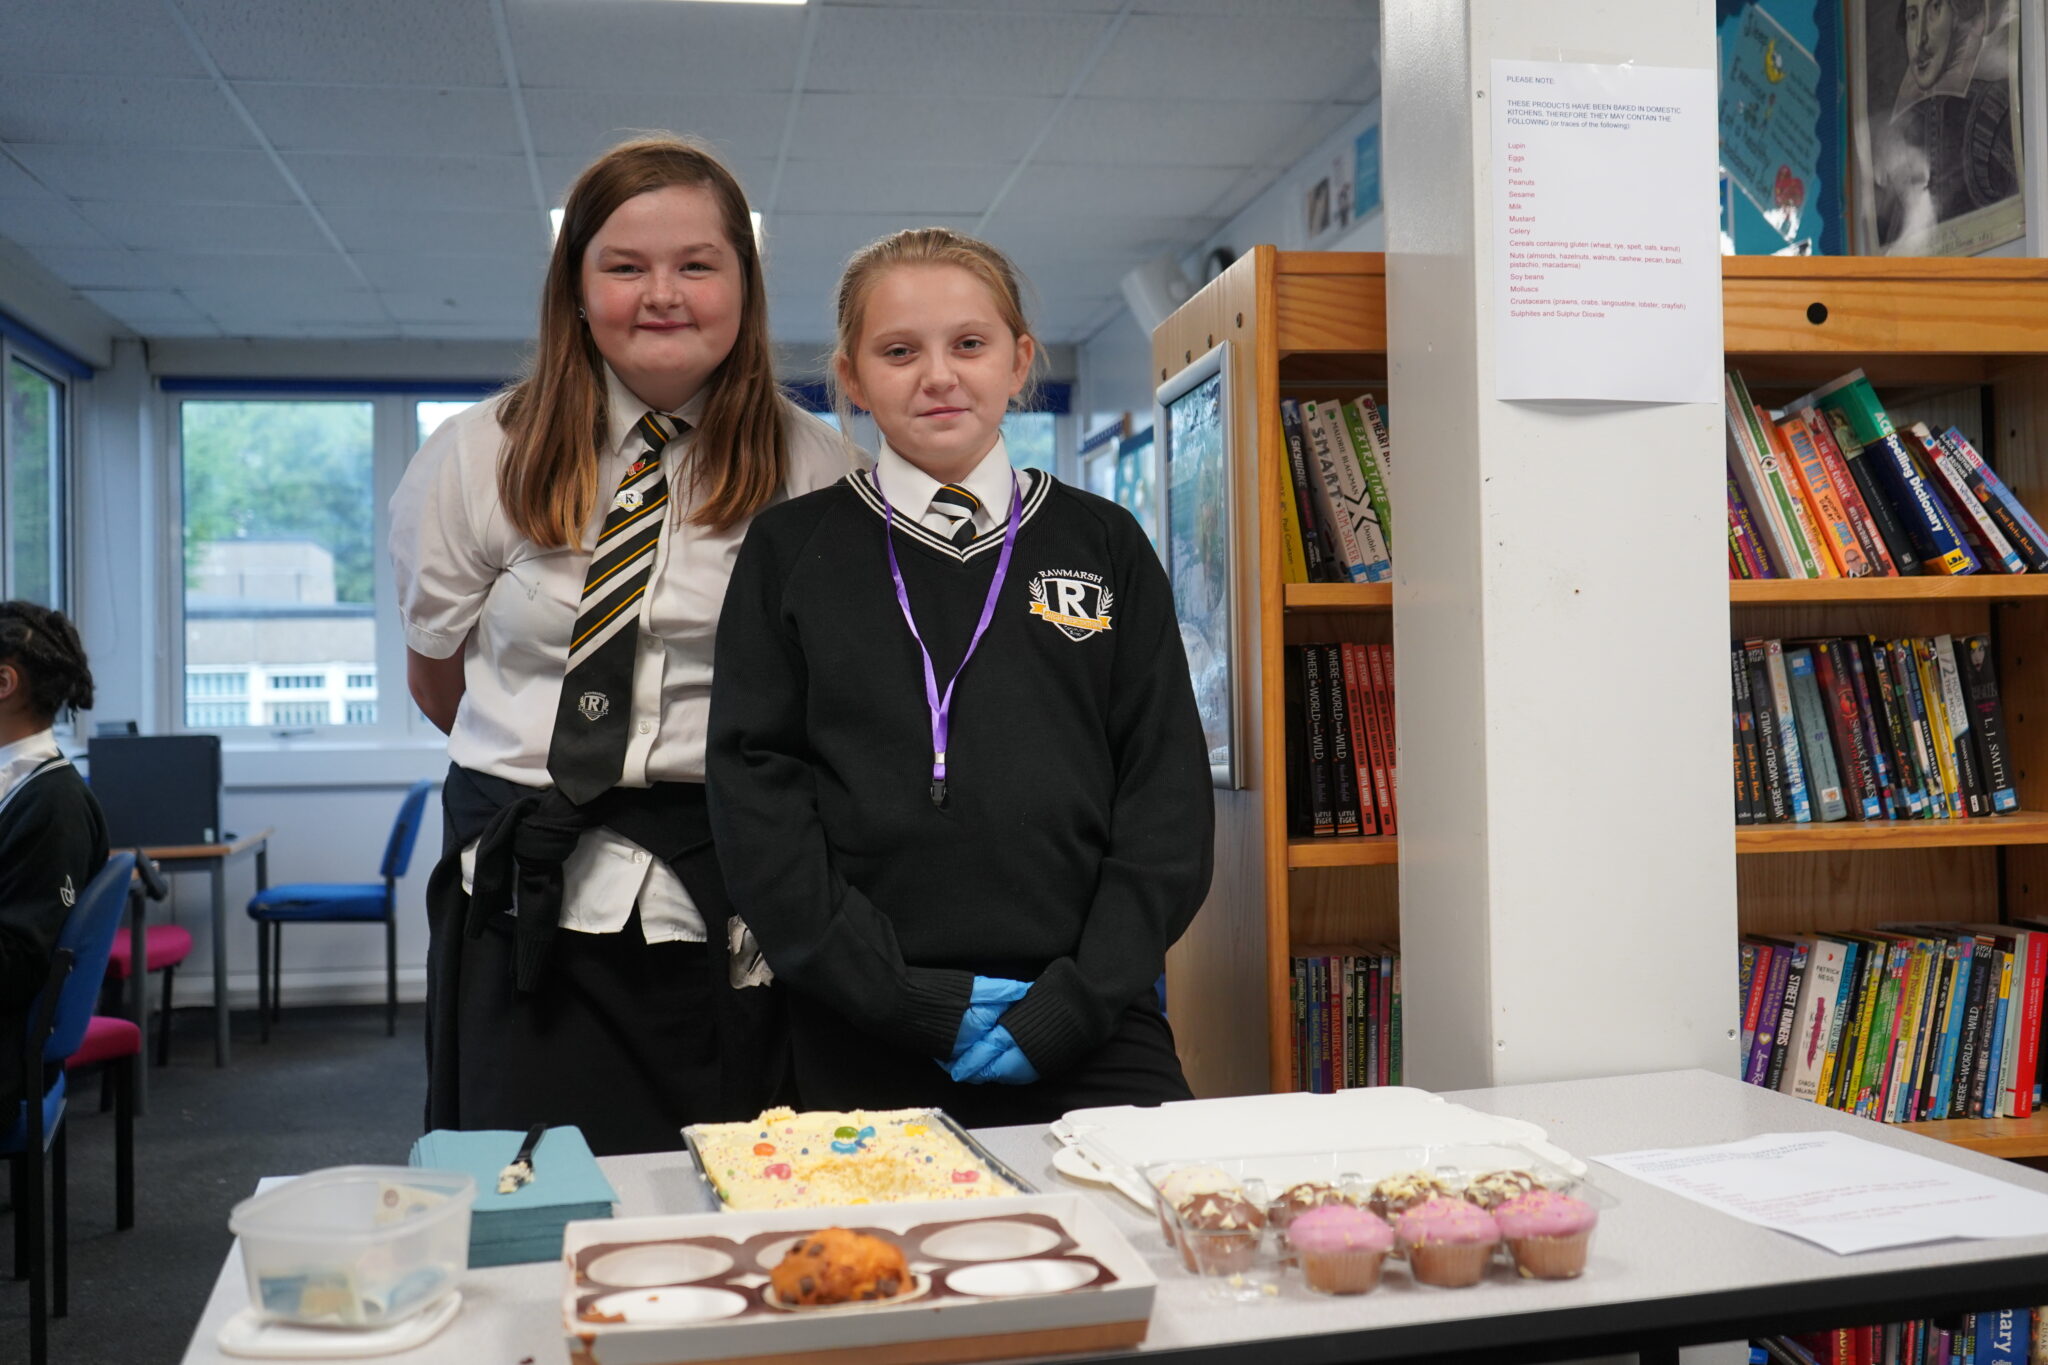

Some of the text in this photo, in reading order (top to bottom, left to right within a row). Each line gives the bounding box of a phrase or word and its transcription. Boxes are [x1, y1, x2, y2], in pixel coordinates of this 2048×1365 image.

[1506, 75, 1534, 84] PLEASE
[1507, 100, 1531, 108] THESE
[1532, 101, 1570, 110] PRODUCTS
[1572, 103, 1591, 111] HAVE
[1592, 103, 1612, 111] BEEN
[1613, 104, 1636, 112] BAKED
[1646, 106, 1681, 114] DOMESTIC
[1546, 110, 1588, 119] THEREFORE
[1609, 112, 1625, 120] MAY
[1626, 113, 1657, 121] CONTAIN
[1507, 118, 1549, 126] FOLLOWING
[1561, 120, 1580, 128] traces
[1508, 154, 1525, 163] Eggs
[1509, 227, 1531, 235] Celery
[1510, 273, 1523, 281] Soy
[1556, 310, 1581, 318] Sulphur
[1661, 302, 1687, 310] crayfish)
[1373, 421, 1390, 451] HEART
[1355, 427, 1387, 502] EXTRA TIME
[1791, 429, 1830, 493] HARRY HILL'S
[1875, 409, 1943, 532] ACE Spelling Dictionary
[1950, 431, 1998, 488] LOOK BOTH WAYS
[1331, 421, 1376, 553] MALORIE BLACKMAN Double
[1824, 455, 1837, 471] DOG
[1832, 470, 1851, 499] RUNNER
[1311, 427, 1360, 563] SMART KIM SLATER
[1738, 509, 1771, 572] Jacqueline Wilson
[1834, 522, 1853, 544] JOKE
[1948, 556, 1964, 566] LDA
[1038, 568, 1104, 584] RAWMARSH
[1057, 580, 1090, 620] R
[1307, 649, 1318, 679] WHERE
[1327, 649, 1340, 678] WHERE
[1345, 648, 1355, 685] MY STORY
[1357, 651, 1368, 686] MY STORY
[1309, 687, 1321, 721] WORLD
[1331, 686, 1344, 721] WORLD
[1944, 679, 1961, 727] THE MOON
[1950, 676, 1967, 726] HOURS ON
[1760, 711, 1772, 736] WILD
[1784, 723, 1796, 750] LINDA
[1312, 734, 1324, 760] WILD
[1335, 733, 1347, 759] WILD
[1922, 720, 1939, 779] MELVIN BURGESS
[1984, 717, 2006, 790] L. J. SMITH
[1376, 769, 1387, 788] SUFIYA
[1766, 748, 1779, 782] WORLD
[1859, 759, 1877, 799] HOLMES
[1359, 766, 1371, 807] SUFIYA AHMED
[1379, 788, 1388, 807] AHMED
[1771, 788, 1784, 818] WHERE
[1816, 965, 1840, 975] PATRICK
[1818, 974, 1835, 983] NESS
[1776, 973, 1802, 1046] STREET RUNNERS
[1967, 1006, 1979, 1030] WILD
[1983, 1038, 1989, 1048] OF
[1984, 1020, 1992, 1038] MICE
[1775, 1048, 1784, 1068] MATT
[1960, 1043, 1974, 1076] WORLD
[1999, 1067, 2007, 1085] Orwell
[1955, 1082, 1968, 1113] WHERE
